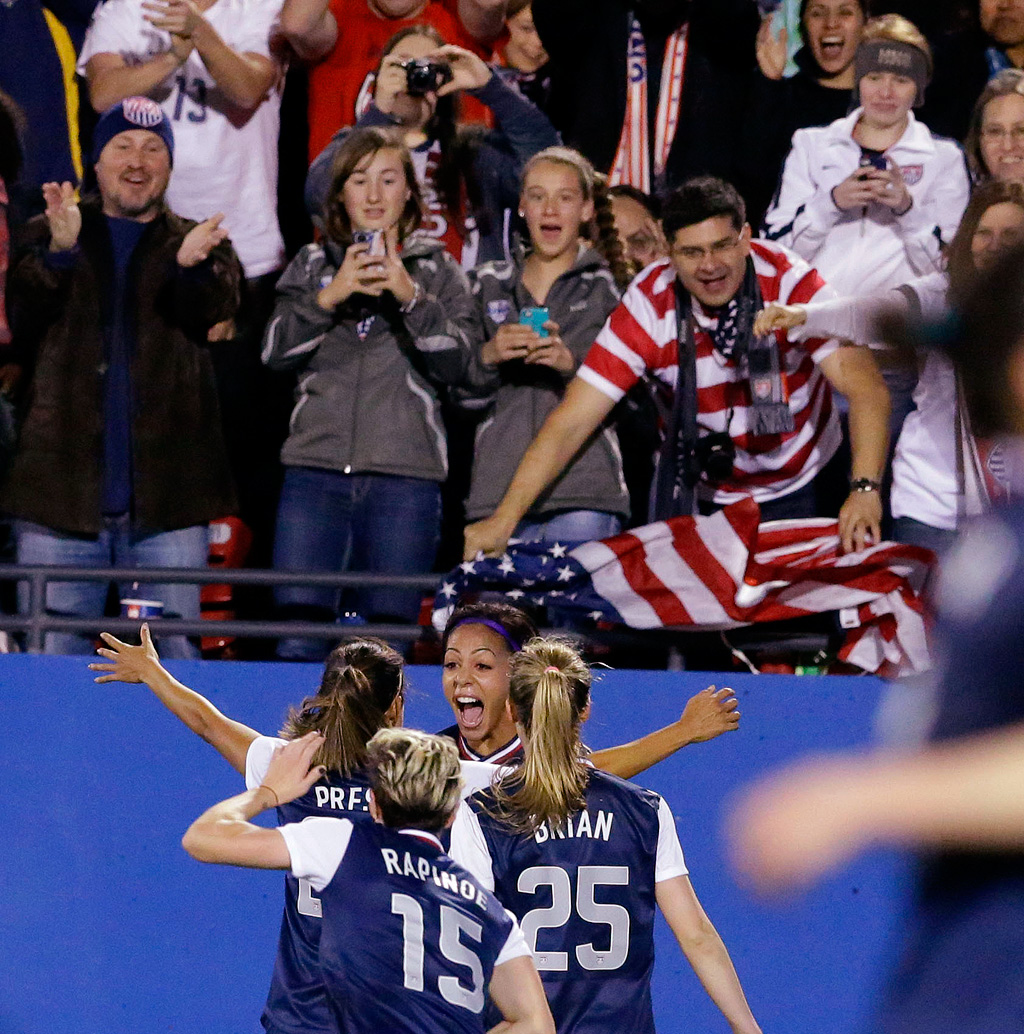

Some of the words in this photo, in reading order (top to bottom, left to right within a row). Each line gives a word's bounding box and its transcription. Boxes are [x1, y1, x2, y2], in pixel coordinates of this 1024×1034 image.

[174, 75, 207, 123] 13
[529, 809, 614, 844] BRIAN
[381, 848, 488, 911] RAPINOE
[517, 866, 630, 971] 25
[391, 893, 485, 1014] 15
